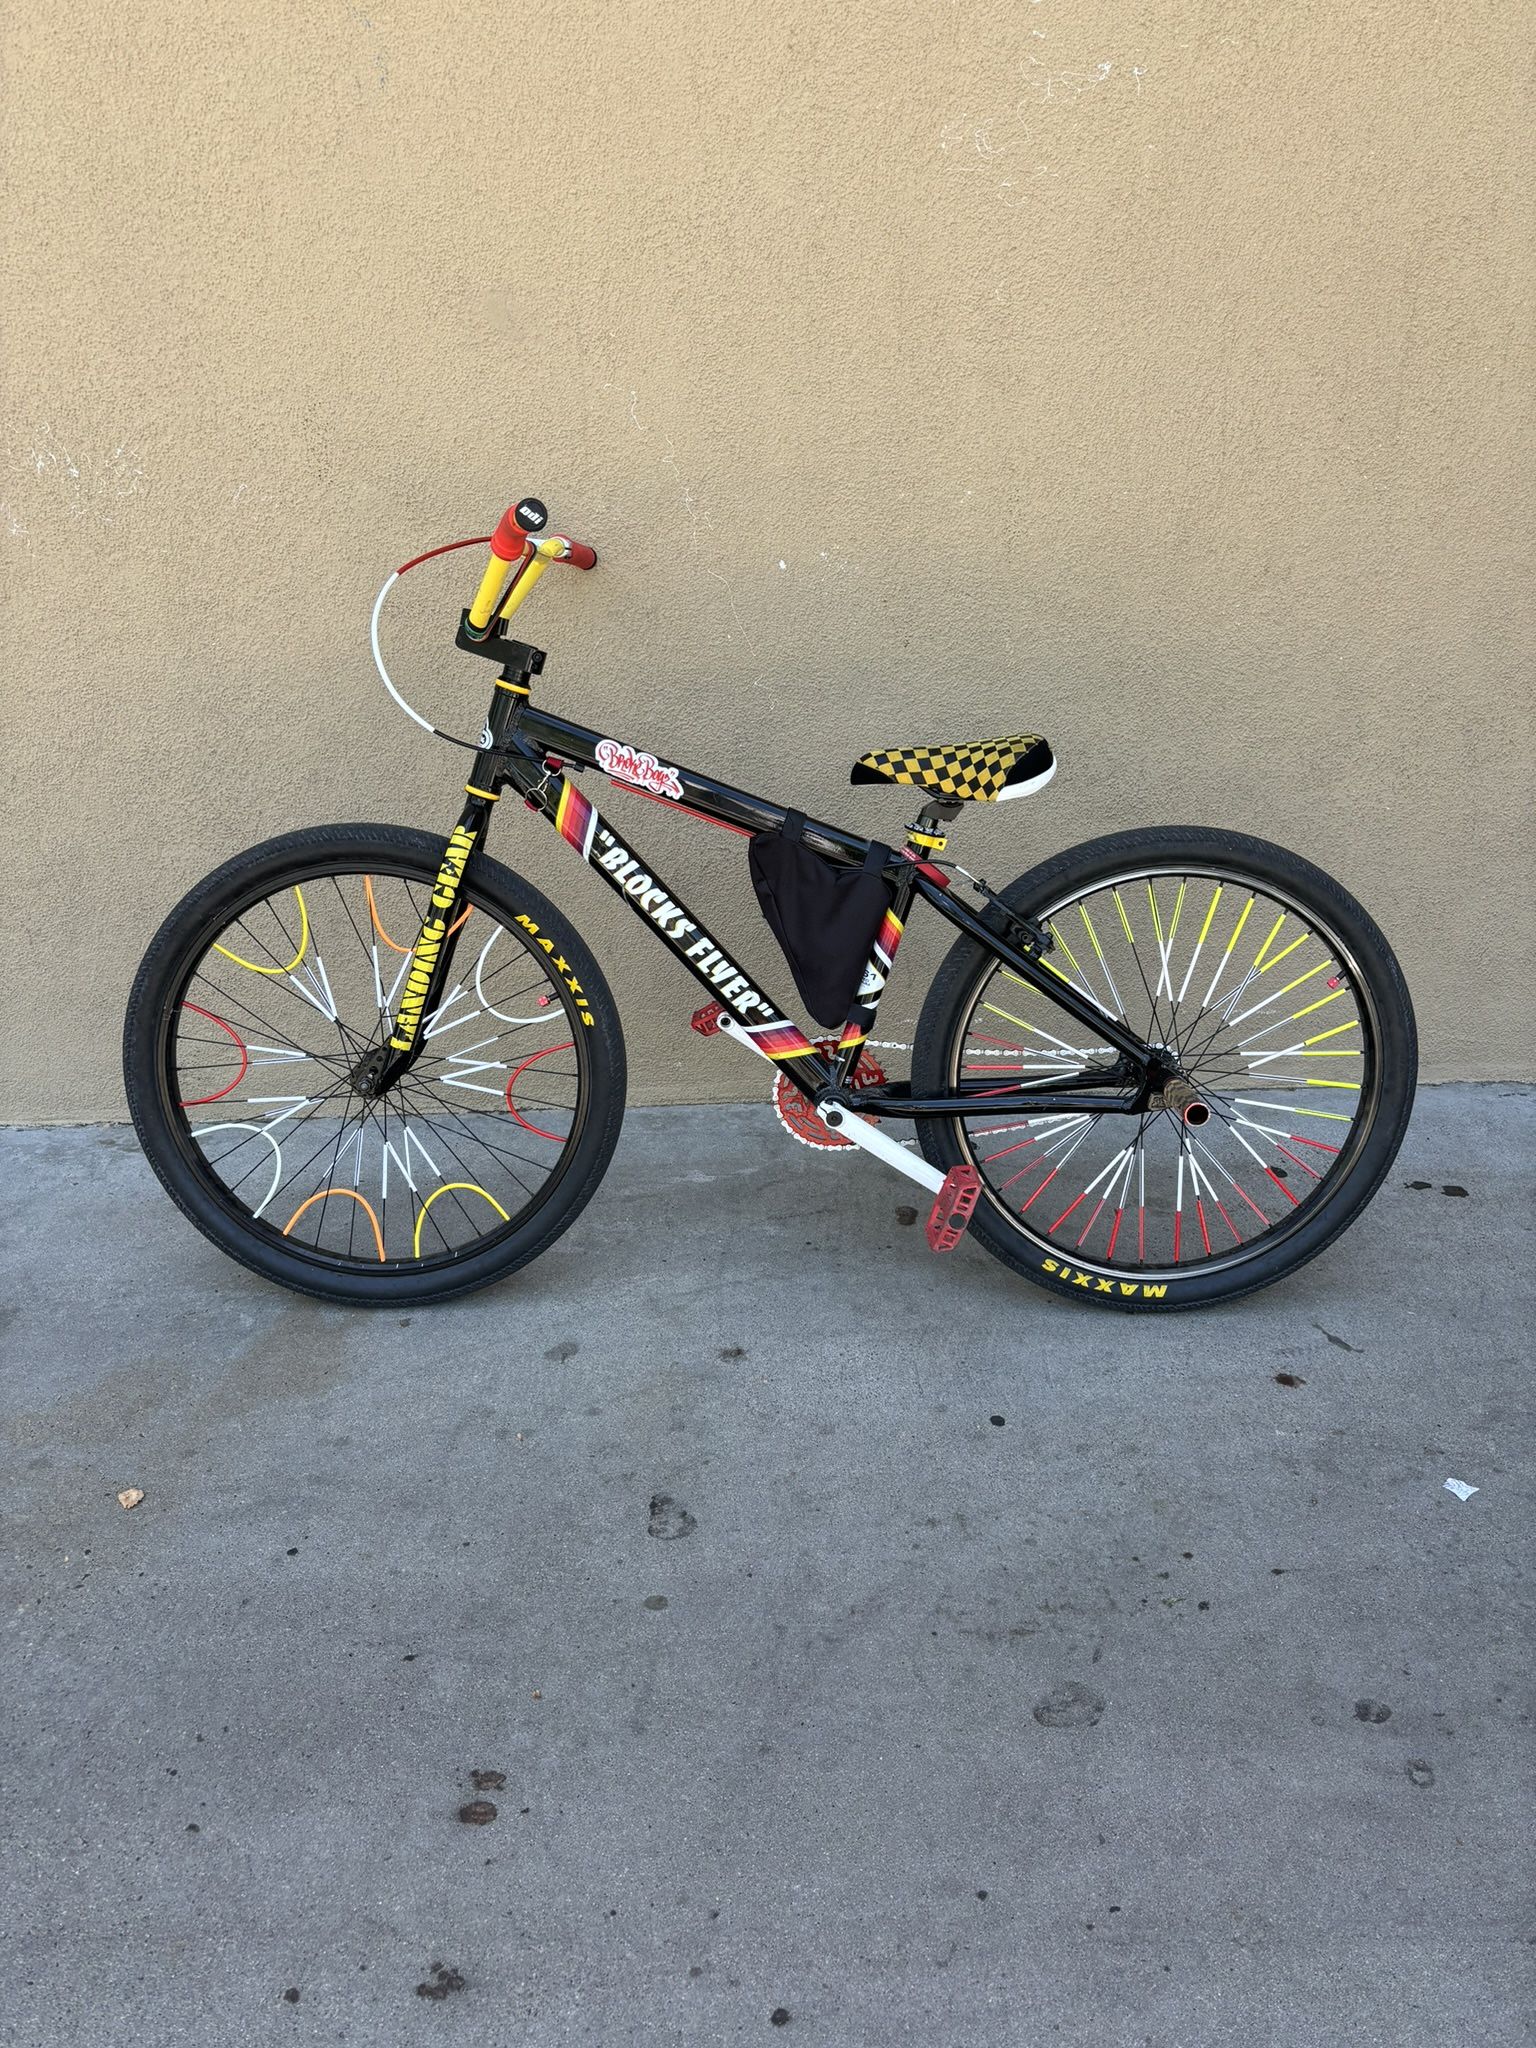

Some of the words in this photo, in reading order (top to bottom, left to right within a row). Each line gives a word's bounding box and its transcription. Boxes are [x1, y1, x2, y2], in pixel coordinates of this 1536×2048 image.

[390, 916, 447, 1051] LANDING
[432, 825, 477, 909] GEAR
[514, 913, 595, 1028] MAXXIS
[1041, 1257, 1168, 1298] MAXXIS
